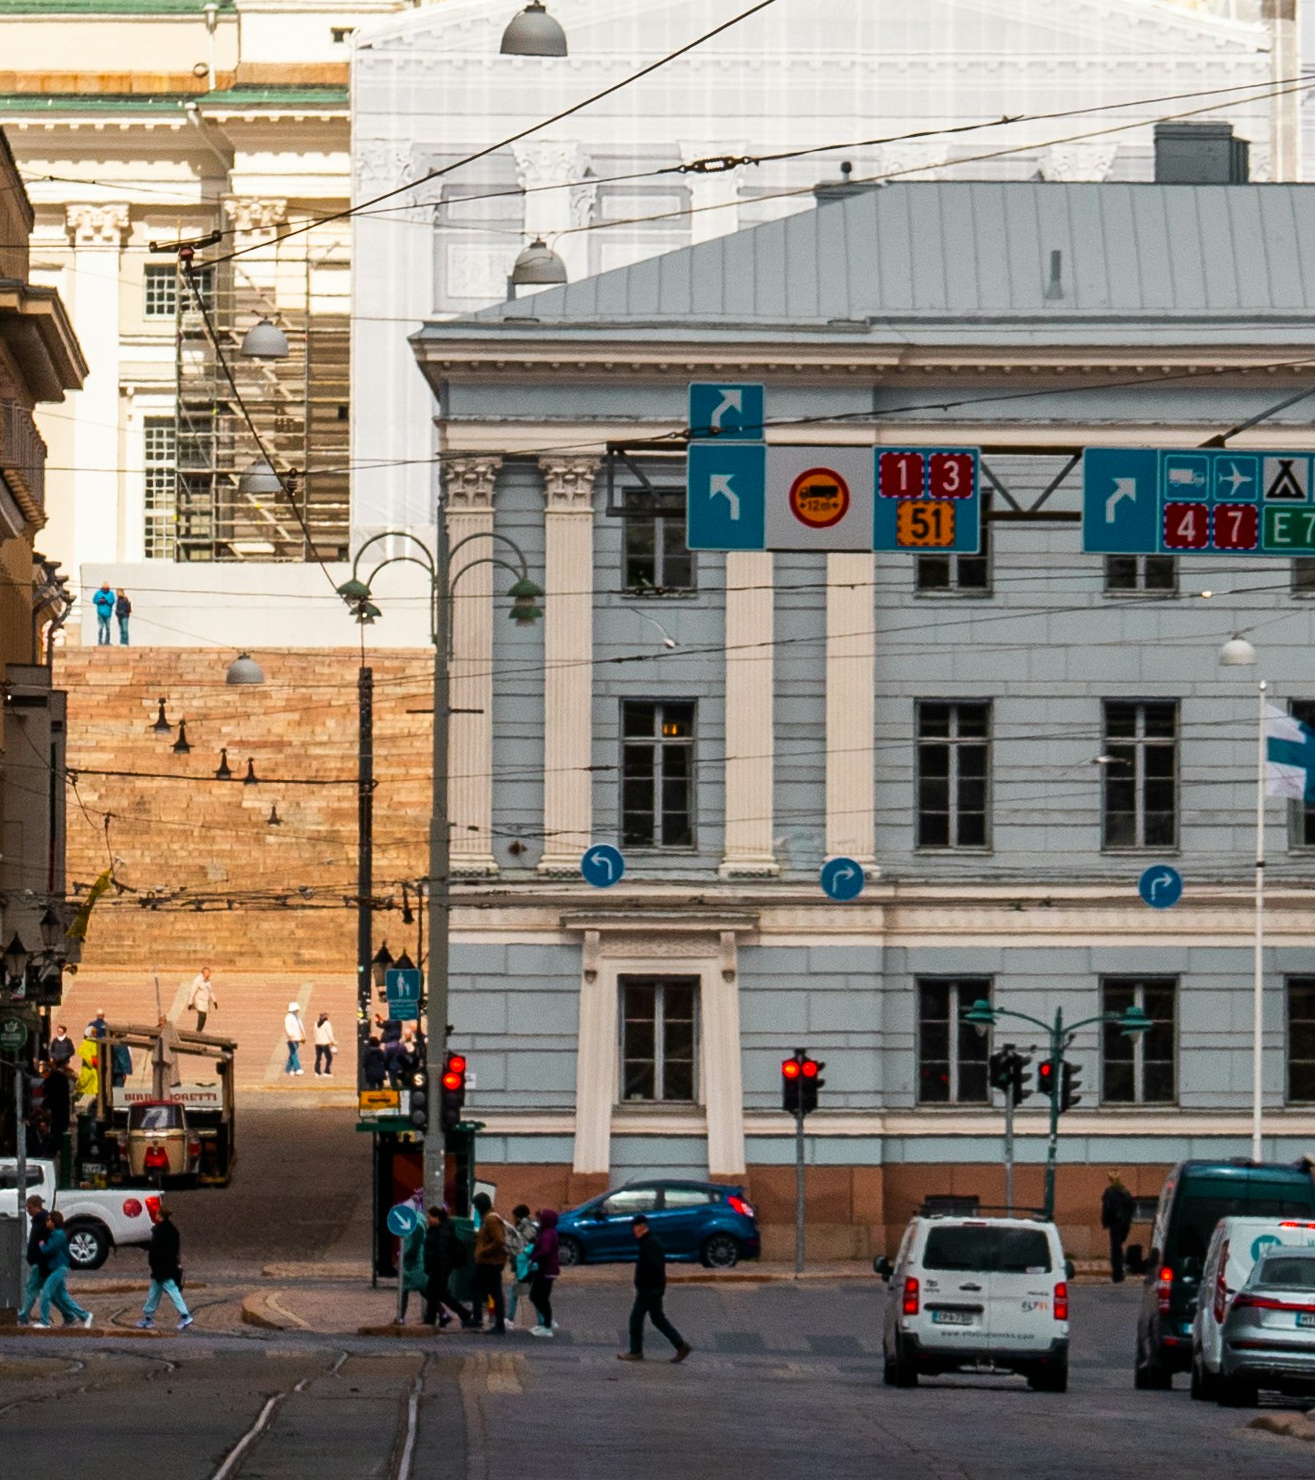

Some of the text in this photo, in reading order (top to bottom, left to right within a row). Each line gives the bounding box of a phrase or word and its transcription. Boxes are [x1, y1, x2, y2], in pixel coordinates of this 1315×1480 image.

[897, 459, 960, 491] 1 3
[911, 507, 942, 540] 51
[1177, 510, 1243, 542] 4 7
[1274, 512, 1291, 543] E
